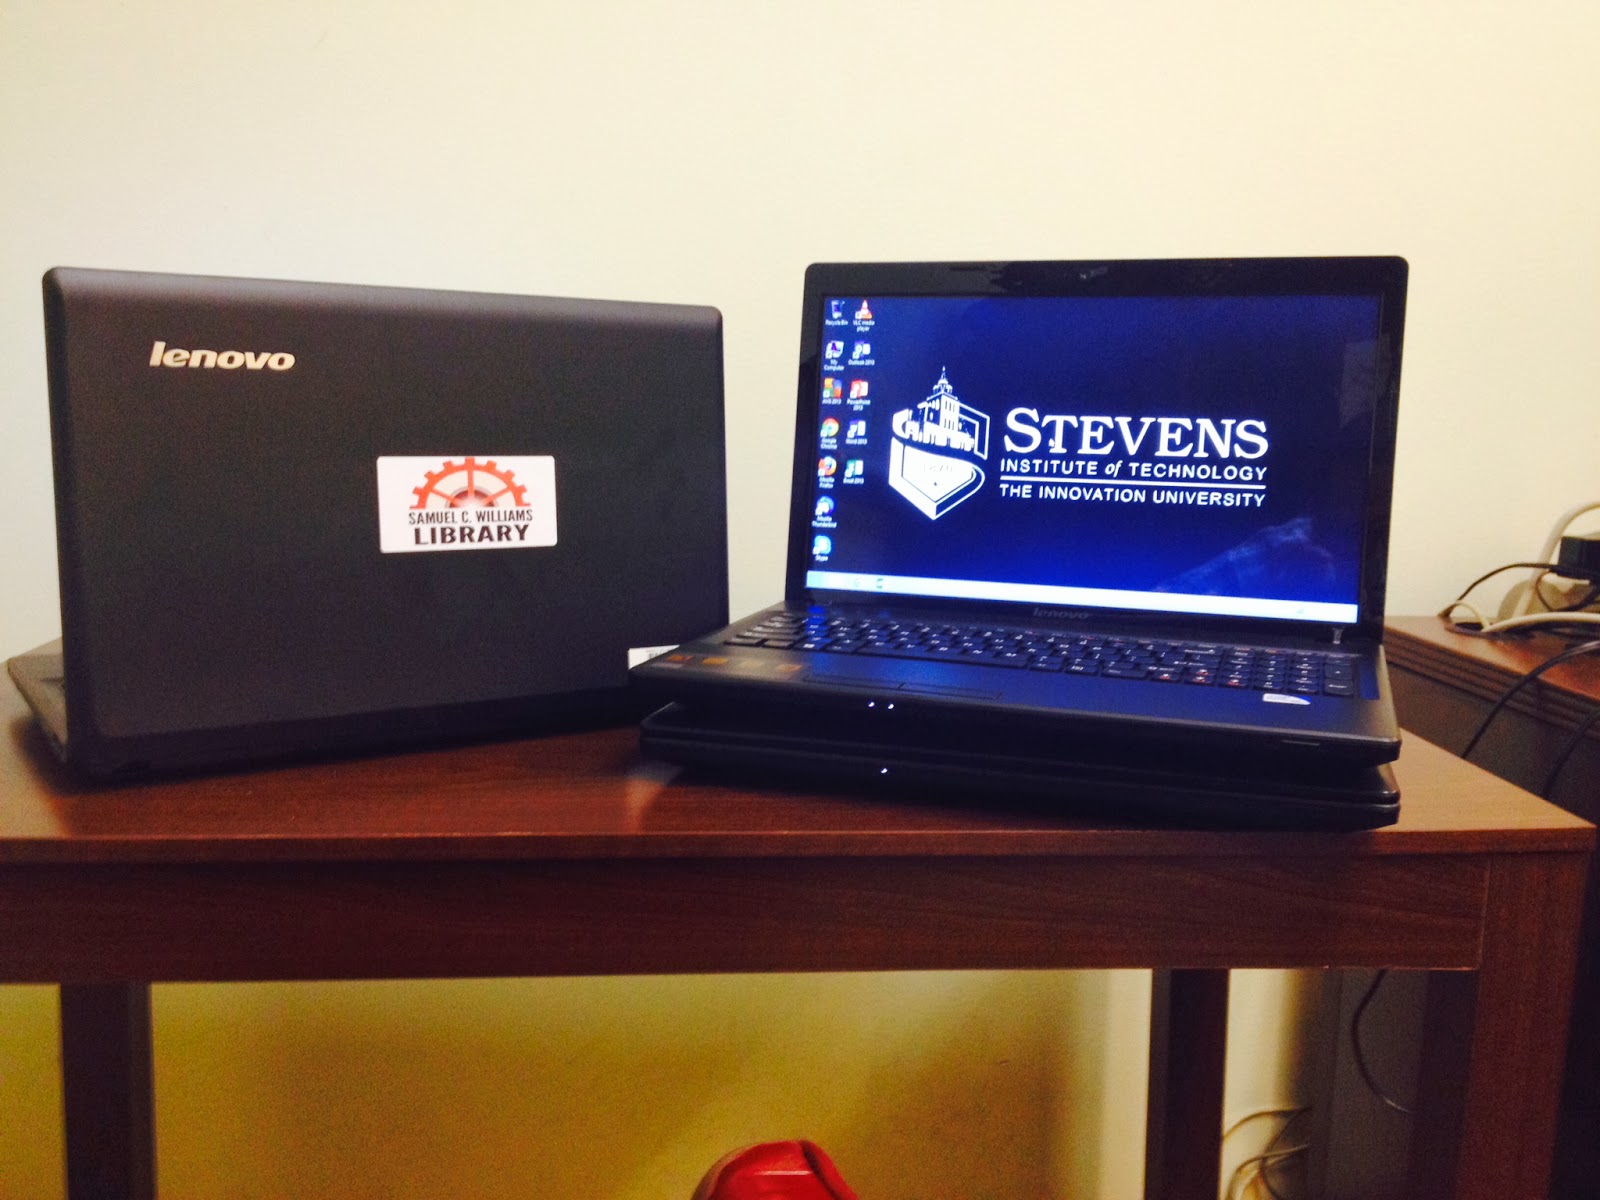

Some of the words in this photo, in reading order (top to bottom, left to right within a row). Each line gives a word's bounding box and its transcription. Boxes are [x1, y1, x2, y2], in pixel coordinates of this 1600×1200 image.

[149, 340, 296, 371] lenovo
[1004, 406, 1270, 460] STEVENS
[1000, 458, 1099, 476] INSTITUTE
[1105, 460, 1123, 478] of
[1129, 462, 1268, 481] TECHNOLOGY
[999, 483, 1033, 499] THE
[1039, 485, 1147, 503] INNOVATION
[1152, 490, 1266, 508] UNIVERSITY
[408, 510, 458, 525] SAMUEL
[461, 510, 472, 524] C.
[475, 509, 533, 523] WILLIAMS
[414, 524, 529, 546] LIBRARY
[1033, 607, 1089, 619] lenovo
